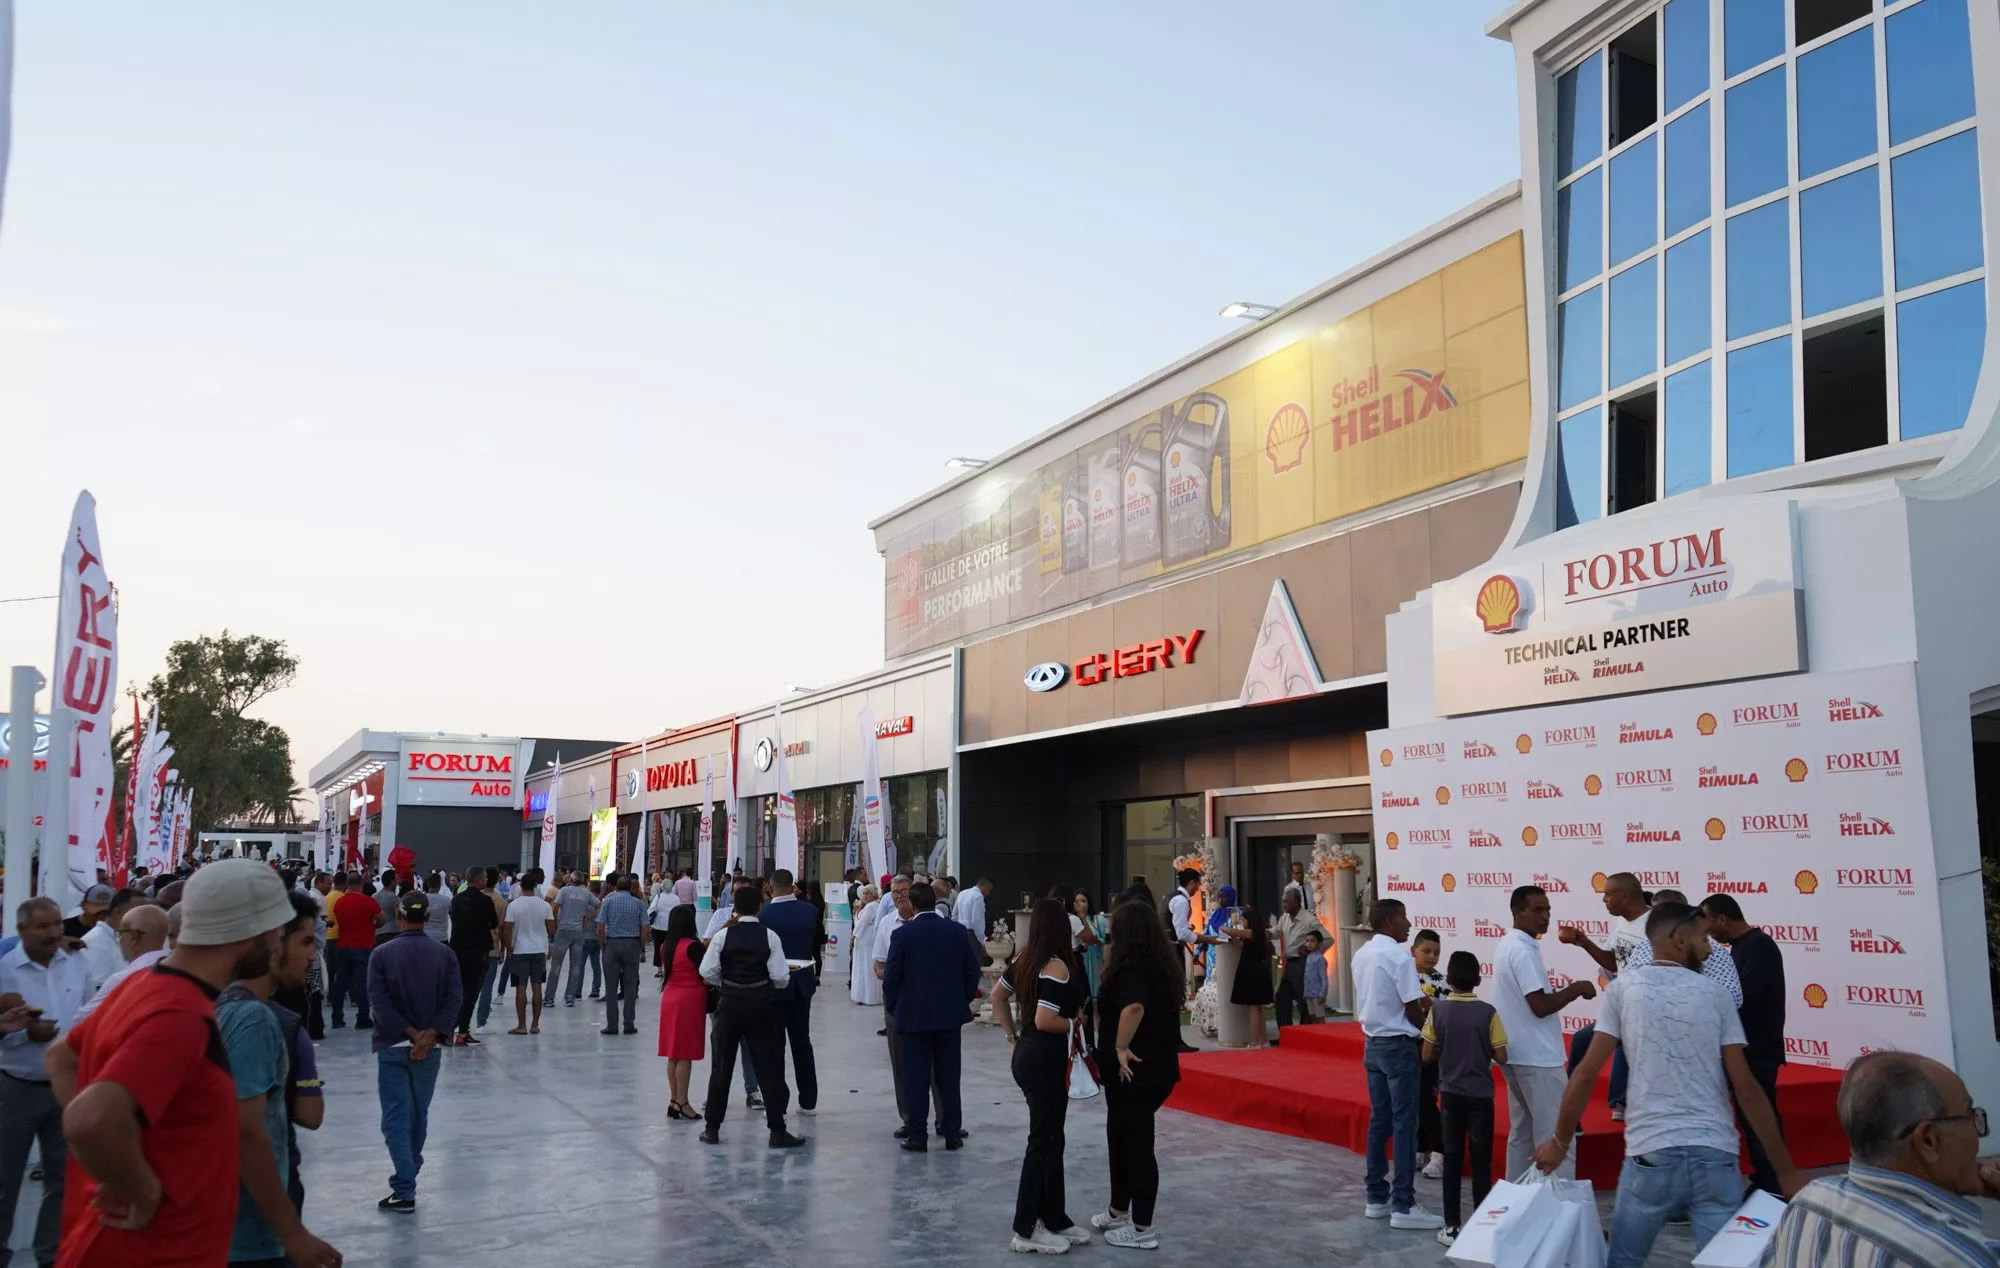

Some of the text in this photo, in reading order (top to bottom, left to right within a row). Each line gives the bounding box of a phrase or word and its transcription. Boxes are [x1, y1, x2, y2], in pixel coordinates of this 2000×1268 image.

[1332, 364, 1379, 410] Shell
[1331, 369, 1456, 452] HELIX
[1169, 475, 1199, 497] HELIX
[1127, 495, 1151, 512] HELIX
[1169, 492, 1198, 509] ULTRA
[1127, 508, 1151, 522] ULTRA
[958, 559, 971, 577] DE
[974, 541, 1009, 570] VOTRE
[1564, 528, 1727, 597] FORUM
[924, 566, 1023, 623] PERFORMANCE
[1690, 577, 1728, 598] Auto
[1504, 617, 1690, 665] TECHNICAL PARTNER
[1074, 629, 1205, 686] CHERY
[1593, 657, 1610, 667] Shell
[1544, 665, 1559, 675] Shell
[1544, 669, 1580, 686] HELIX
[1593, 661, 1645, 679] RIMULA
[1829, 697, 1851, 708] Shell
[1733, 702, 1799, 724] FORUM
[1829, 702, 1884, 722] HELIX
[874, 718, 908, 737] HAVAL
[1544, 726, 1596, 744] FORUM
[1620, 722, 1636, 732] Shell
[1619, 728, 1673, 744] RIMULA
[1403, 742, 1445, 758] FORUM
[1464, 744, 1496, 759] HELIX
[408, 753, 512, 773] FORUM
[1825, 749, 1901, 770] FORUM
[646, 758, 697, 792] TOYOTA
[1616, 768, 1672, 786] FORUM
[1698, 766, 1717, 775] Shell
[1527, 780, 1542, 789] Shell
[1698, 772, 1759, 788] RIMULA
[470, 782, 511, 797] Auto
[1461, 781, 1507, 797] FORUM
[1527, 784, 1563, 799] HELIX
[1381, 797, 1420, 808] RIMULA
[1742, 814, 1809, 830] FORUM
[1839, 812, 1862, 822] Shell
[1469, 829, 1483, 837] Shell
[1550, 823, 1602, 837] FORUM
[1626, 822, 1644, 831] Shell
[1840, 817, 1895, 836] HELIX
[1408, 829, 1451, 842] FORUM
[1469, 833, 1503, 847] HELIX
[1626, 830, 1681, 843] RIMULA
[1467, 872, 1513, 885] FORUM
[1533, 873, 1549, 882] Shell
[1707, 872, 1726, 881] Shell
[1836, 868, 1913, 884] FORUM
[1387, 882, 1425, 892] RIMULA
[1707, 882, 1768, 894] RIMULA
[1414, 915, 1456, 929] FORUM
[1474, 918, 1488, 926] Shell
[1475, 924, 1506, 938] HELIX
[1752, 925, 1819, 941] ORUM
[1850, 929, 1873, 939] Shell
[1804, 945, 1820, 953] Auto
[1850, 935, 1906, 955] HELIX
[1847, 985, 1924, 1006] FORUM
[1908, 1009, 1926, 1018] Auto
[1785, 1038, 1829, 1056] RUM
